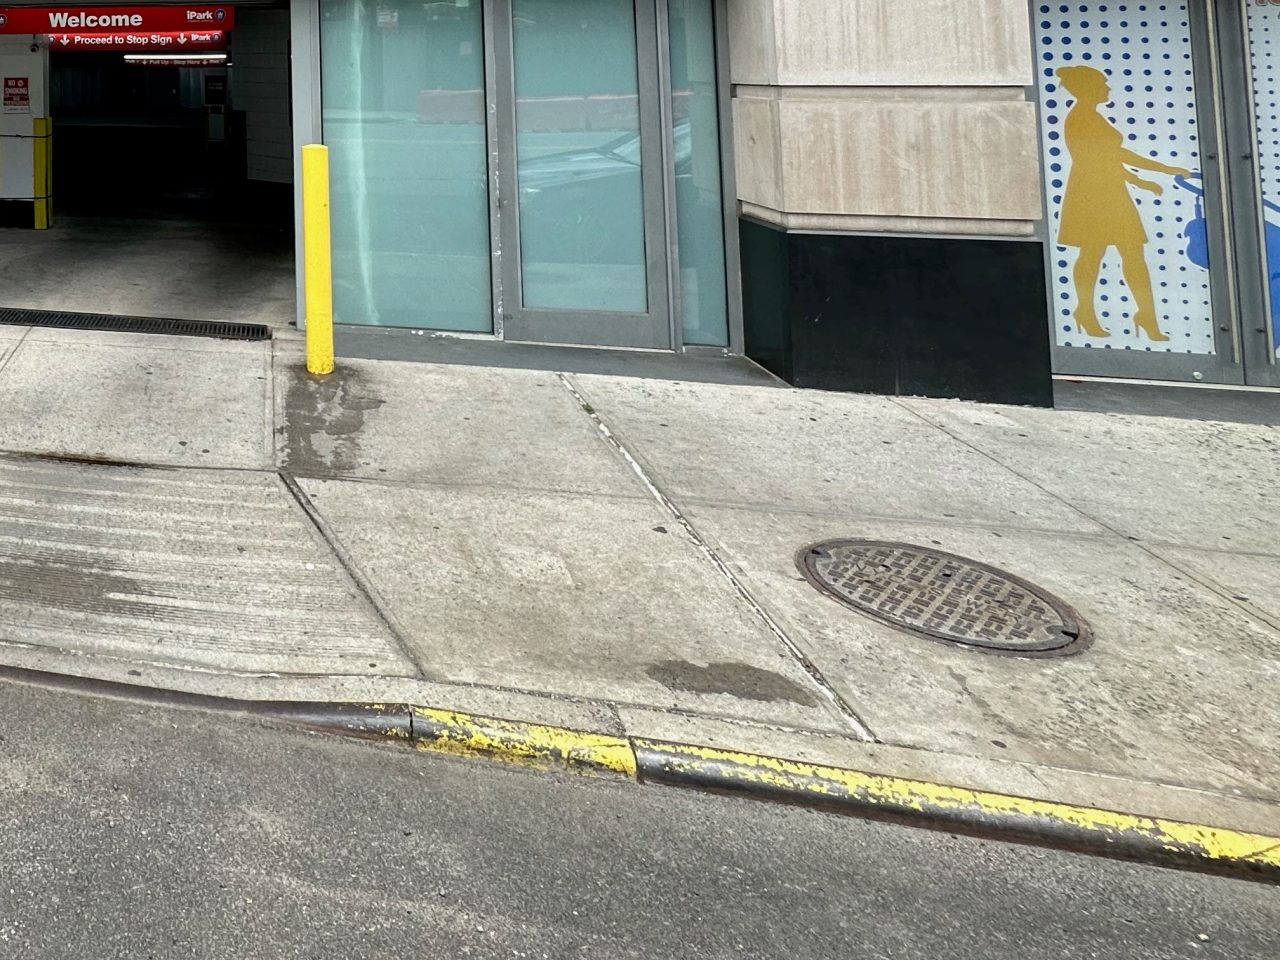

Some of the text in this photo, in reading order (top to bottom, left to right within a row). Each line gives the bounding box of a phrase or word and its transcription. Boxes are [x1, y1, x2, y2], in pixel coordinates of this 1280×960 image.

[48, 12, 143, 28] Welcome
[186, 10, 213, 20] iPark
[74, 34, 173, 46] Proceed to Stop Sign
[191, 33, 211, 41] iPark
